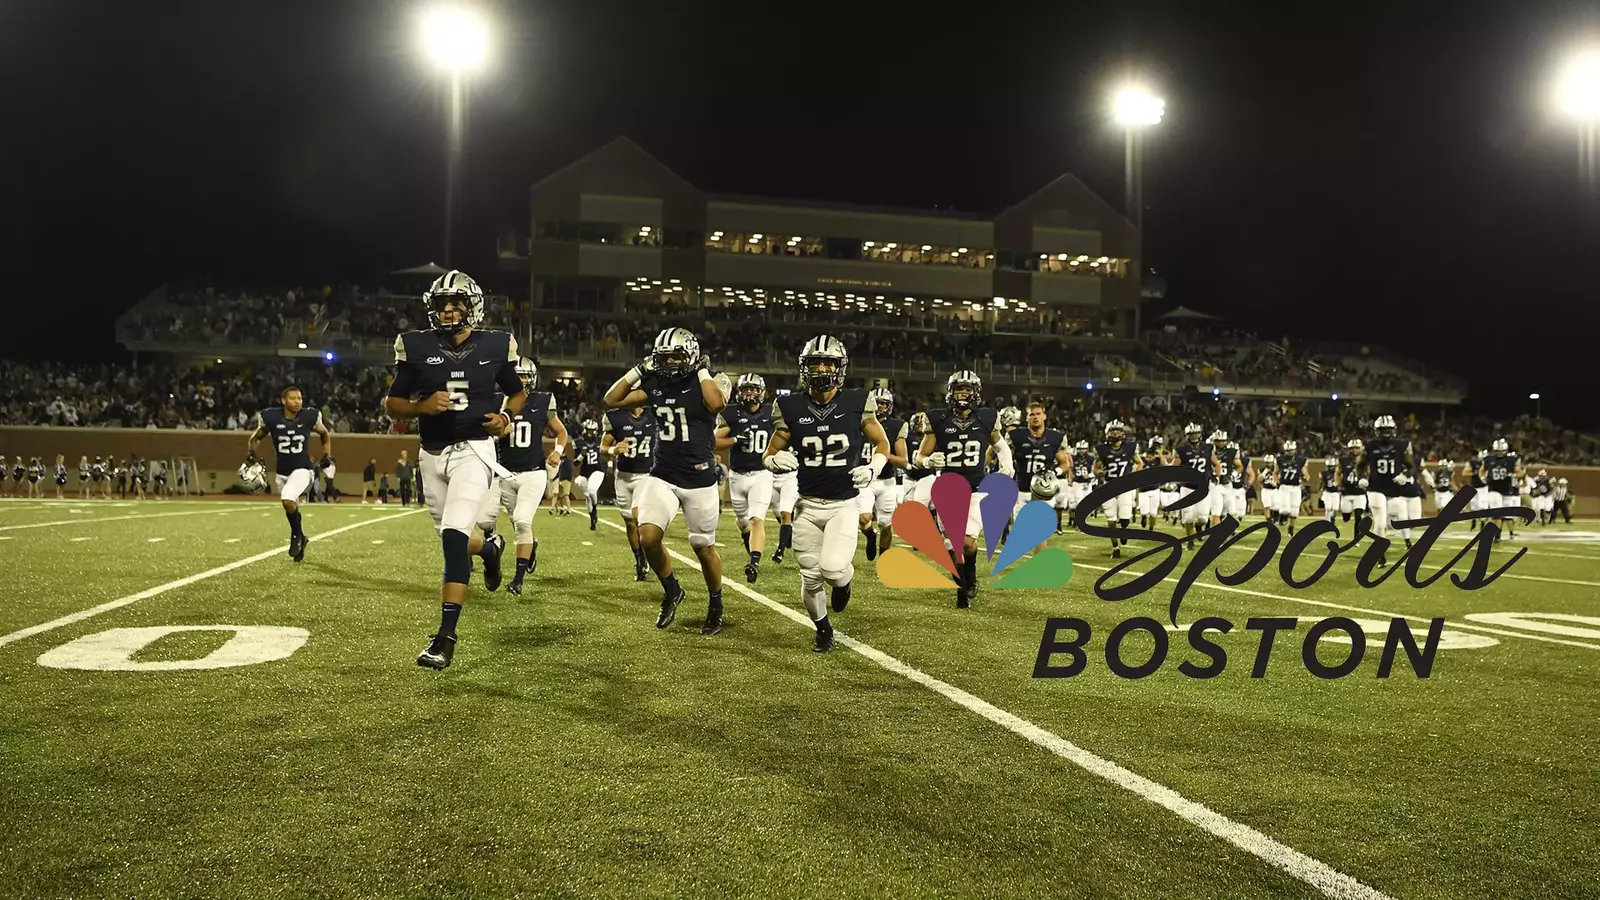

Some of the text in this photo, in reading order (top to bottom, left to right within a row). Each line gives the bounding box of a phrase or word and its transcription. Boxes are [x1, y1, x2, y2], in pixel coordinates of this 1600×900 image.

[446, 381, 469, 411] 5
[656, 406, 690, 442] 31
[278, 435, 305, 454] 23
[509, 421, 532, 448] 10
[586, 452, 599, 465] 12
[802, 433, 850, 467] 32
[946, 440, 981, 467] 29
[1025, 454, 1046, 475] 16
[1108, 461, 1128, 478] 27
[1188, 458, 1207, 473] 72
[1283, 469, 1297, 480] 77
[1377, 459, 1396, 474] 91
